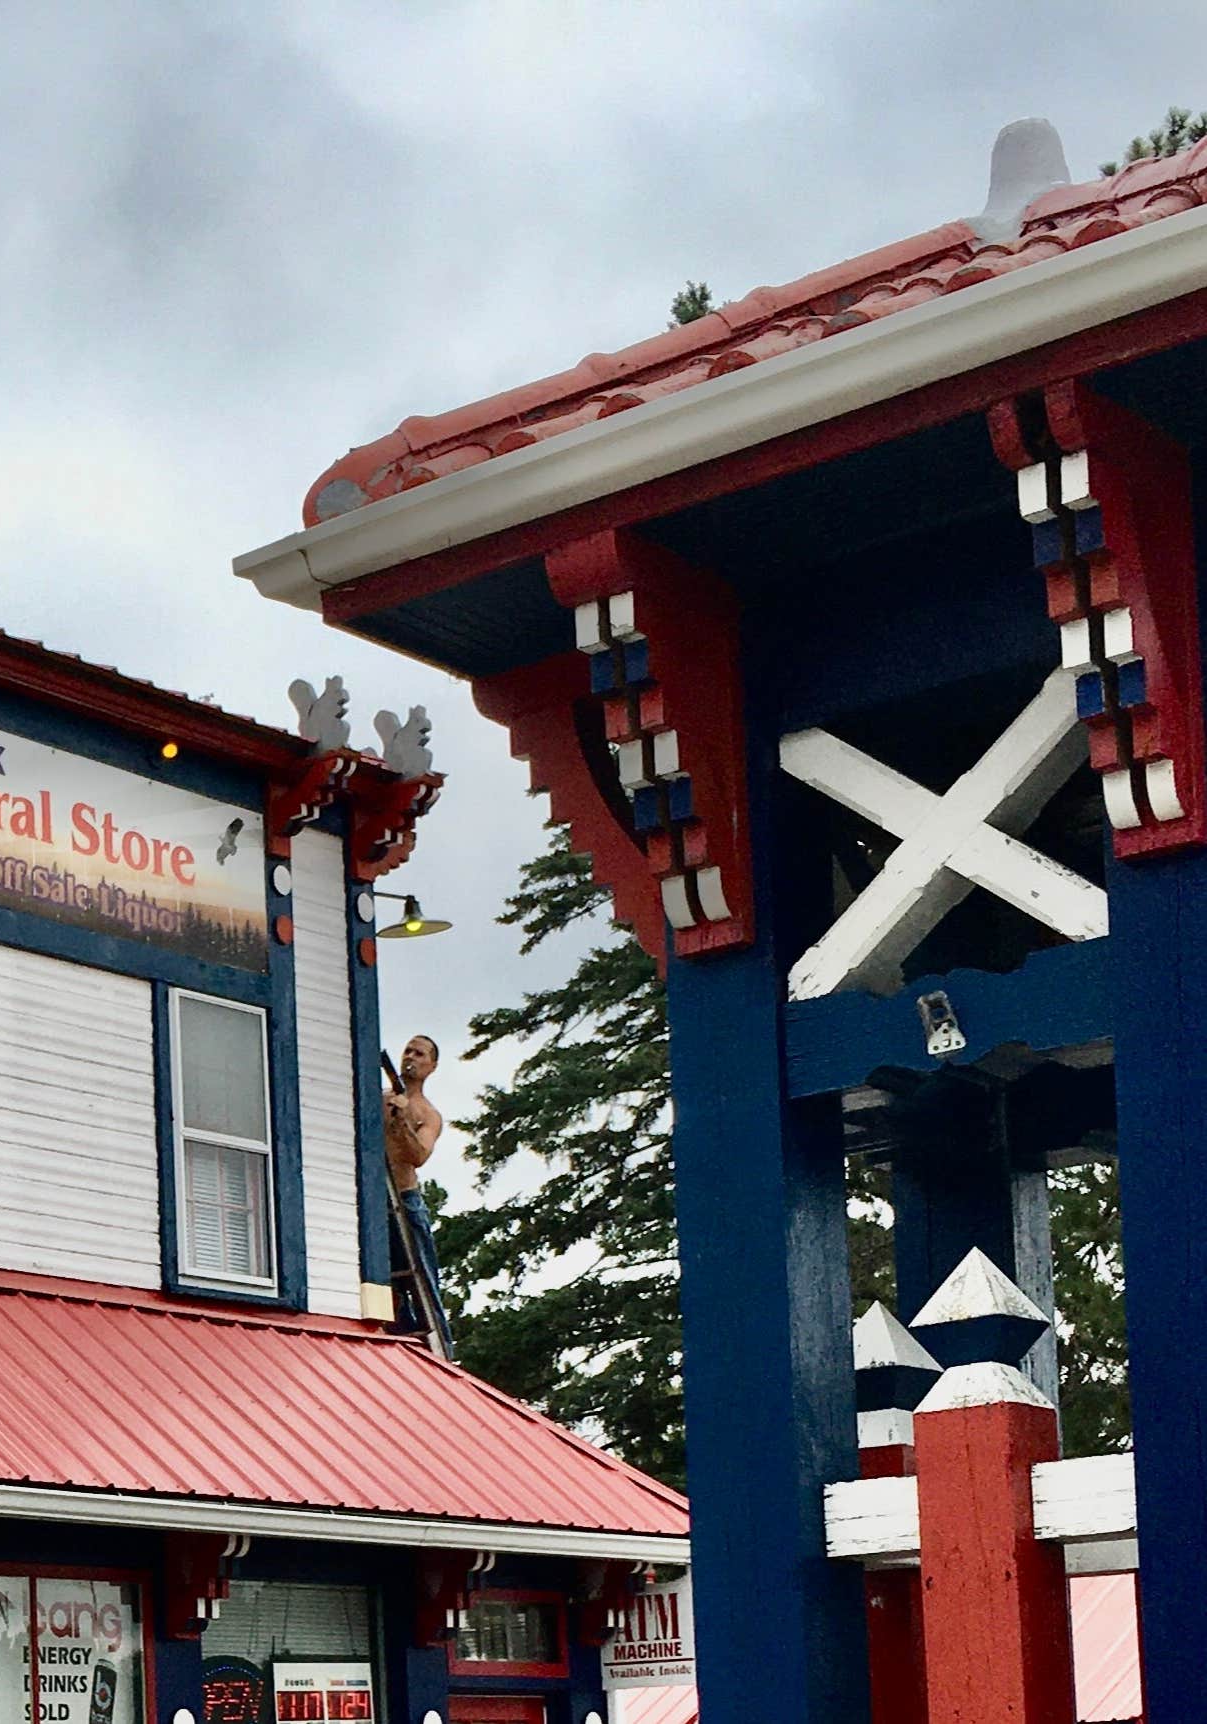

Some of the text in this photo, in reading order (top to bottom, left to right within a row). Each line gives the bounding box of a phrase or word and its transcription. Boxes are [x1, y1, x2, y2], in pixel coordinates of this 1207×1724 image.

[70, 801, 195, 885] Store
[33, 869, 88, 910] Sale
[99, 886, 182, 933] Liquor
[614, 1642, 682, 1660] MACHINE
[609, 1665, 691, 1679] Available Inside
